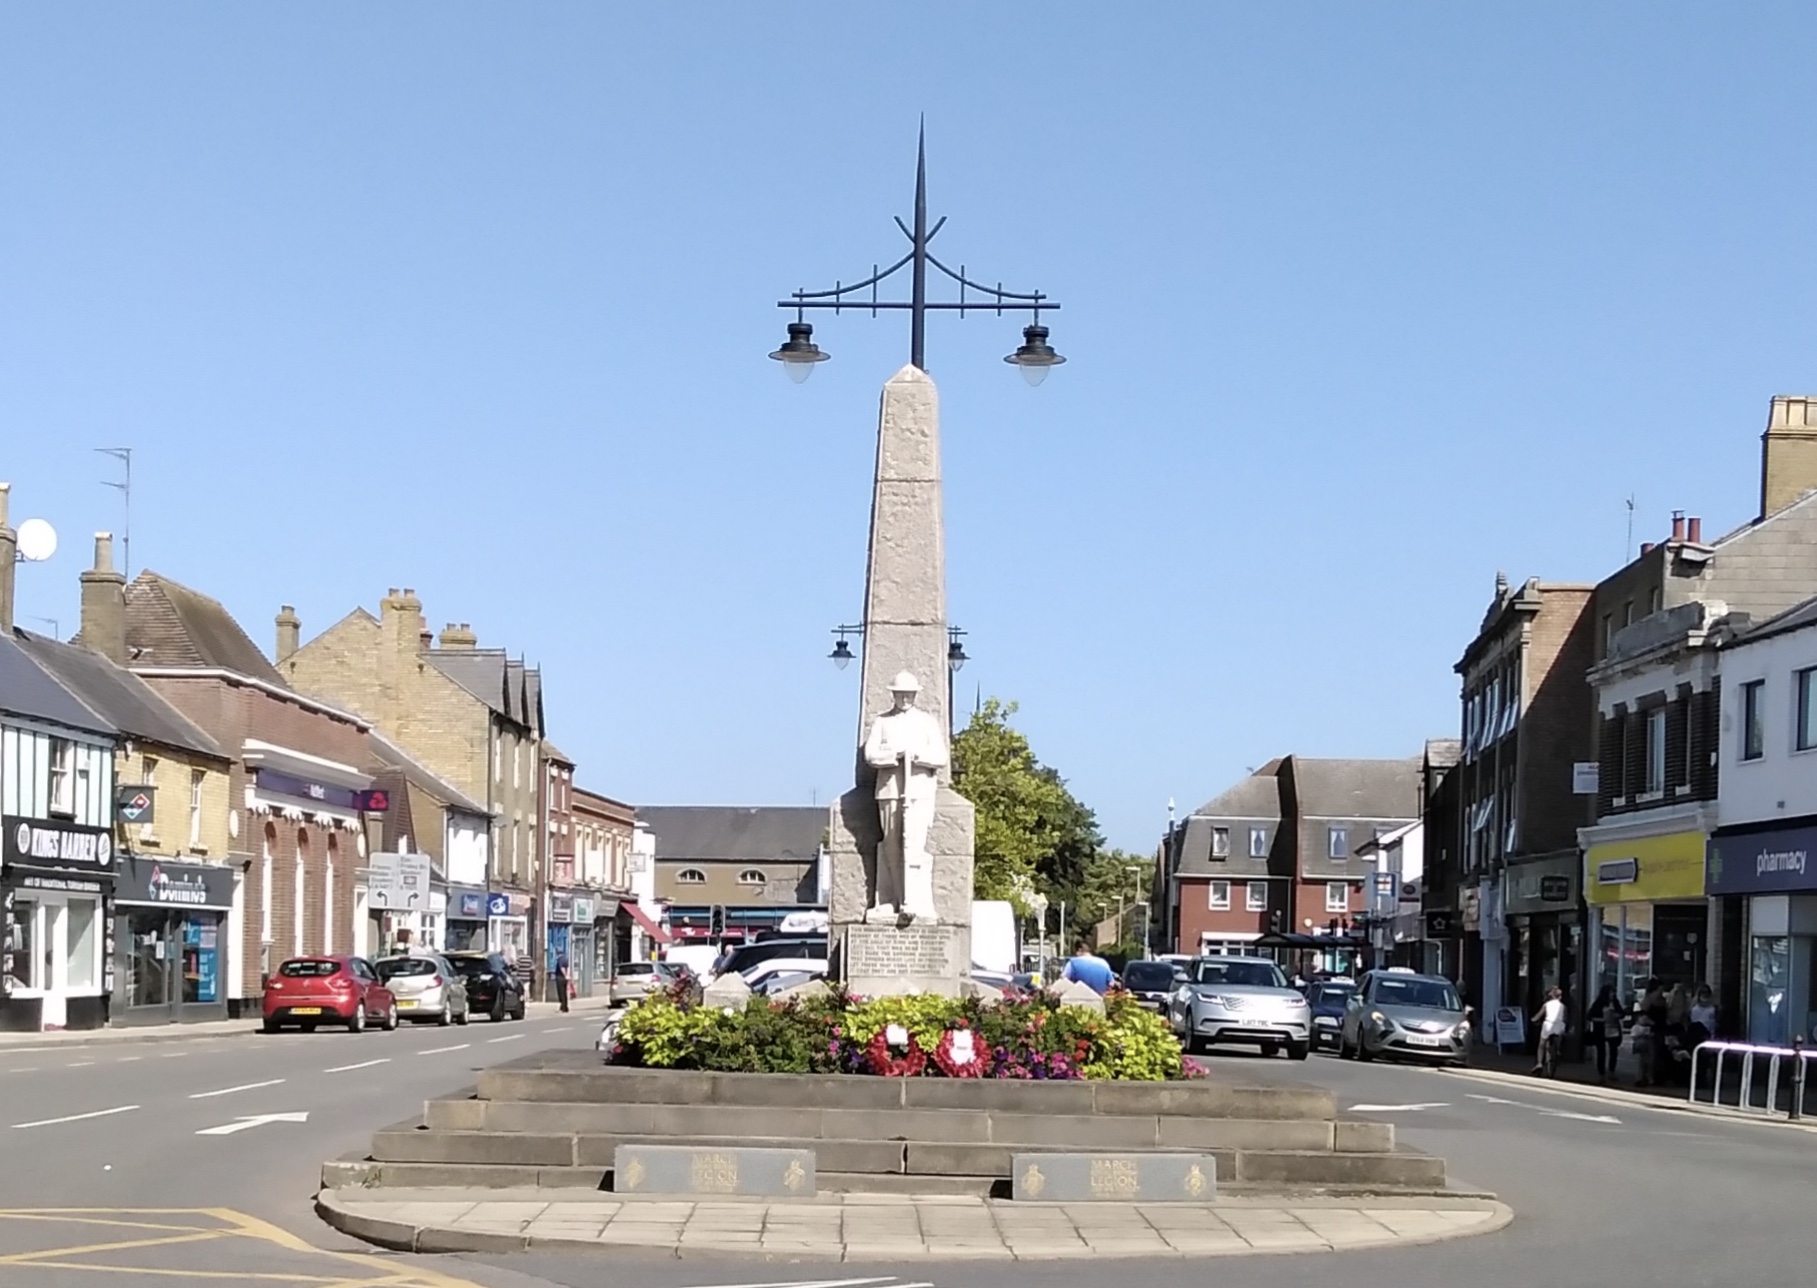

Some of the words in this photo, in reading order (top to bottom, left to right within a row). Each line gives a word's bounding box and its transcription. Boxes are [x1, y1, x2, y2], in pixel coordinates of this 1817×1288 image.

[31, 828, 60, 858] KINGS
[1757, 849, 1807, 876] pharmacy
[1091, 1159, 1137, 1170] MARCH
[1091, 1176, 1137, 1187] LEGION
